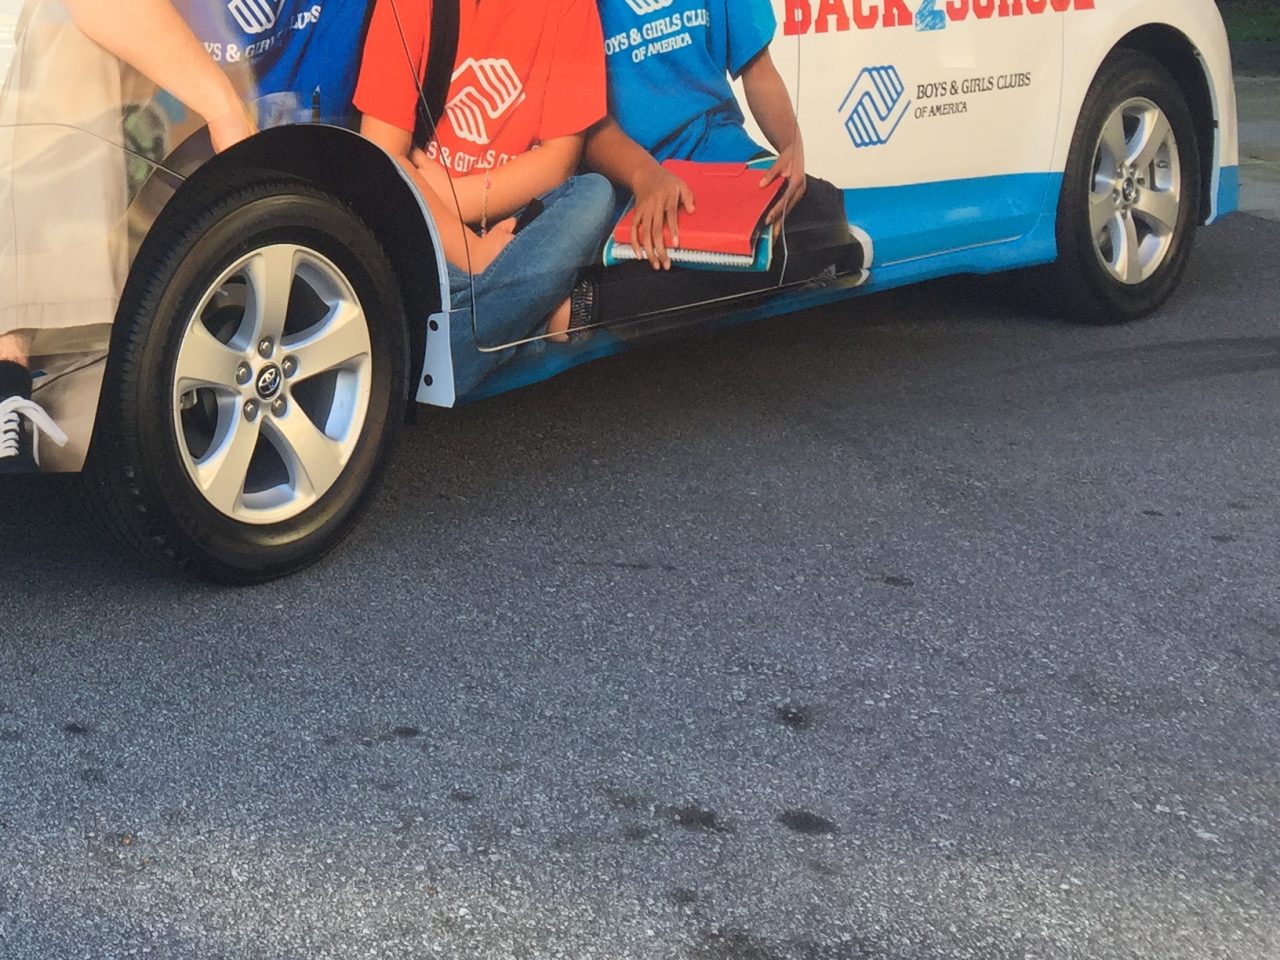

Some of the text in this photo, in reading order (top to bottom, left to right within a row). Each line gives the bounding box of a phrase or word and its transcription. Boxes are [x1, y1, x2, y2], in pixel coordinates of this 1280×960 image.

[605, 32, 628, 55] OYS
[630, 28, 643, 45] &
[643, 14, 681, 40] GIRLS
[226, 43, 240, 62] &
[632, 33, 692, 63] OF AMERICA
[916, 72, 1031, 100] BOYS & GIRLS CLUBS
[914, 101, 968, 119] OF AMERICA
[440, 147, 452, 168] &
